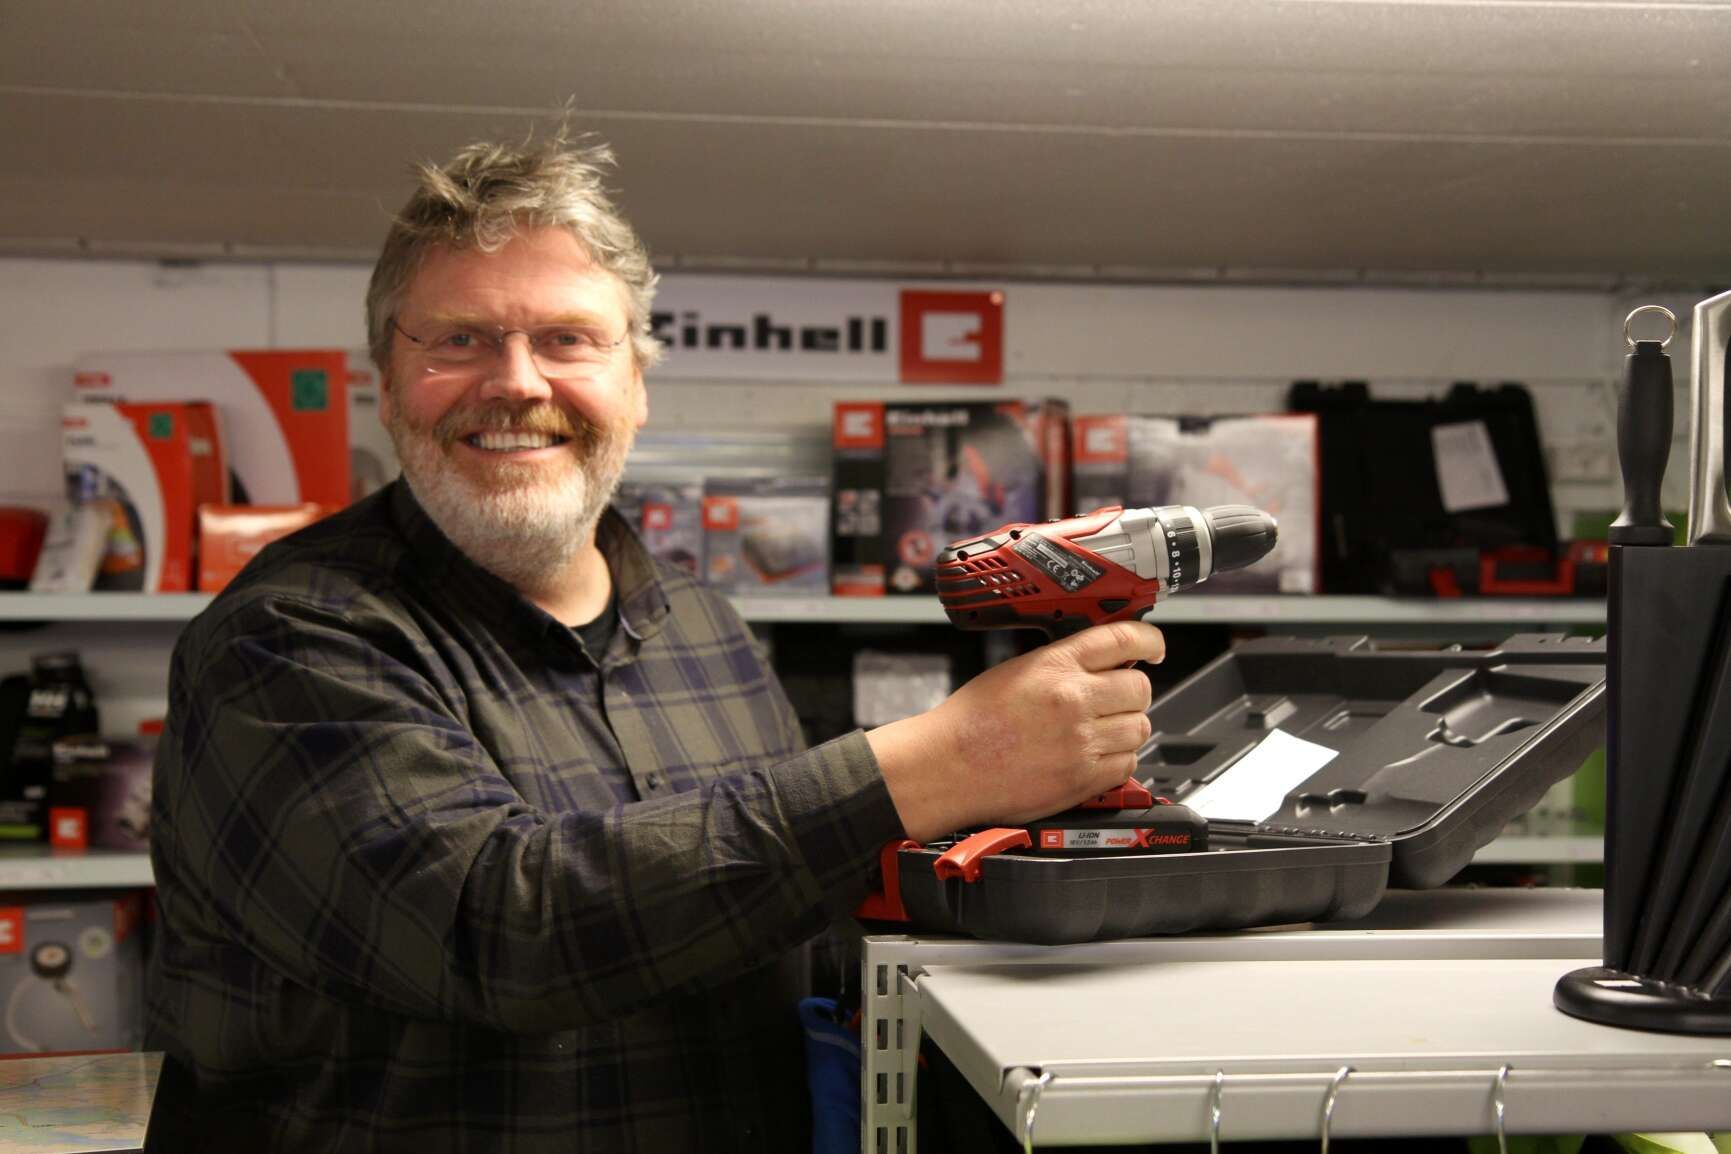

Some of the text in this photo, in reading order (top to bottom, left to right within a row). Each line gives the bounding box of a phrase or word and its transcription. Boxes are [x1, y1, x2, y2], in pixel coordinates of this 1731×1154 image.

[1167, 530, 1176, 538] 6
[1171, 550, 1181, 558] 8
[1172, 567, 1182, 579] 10
